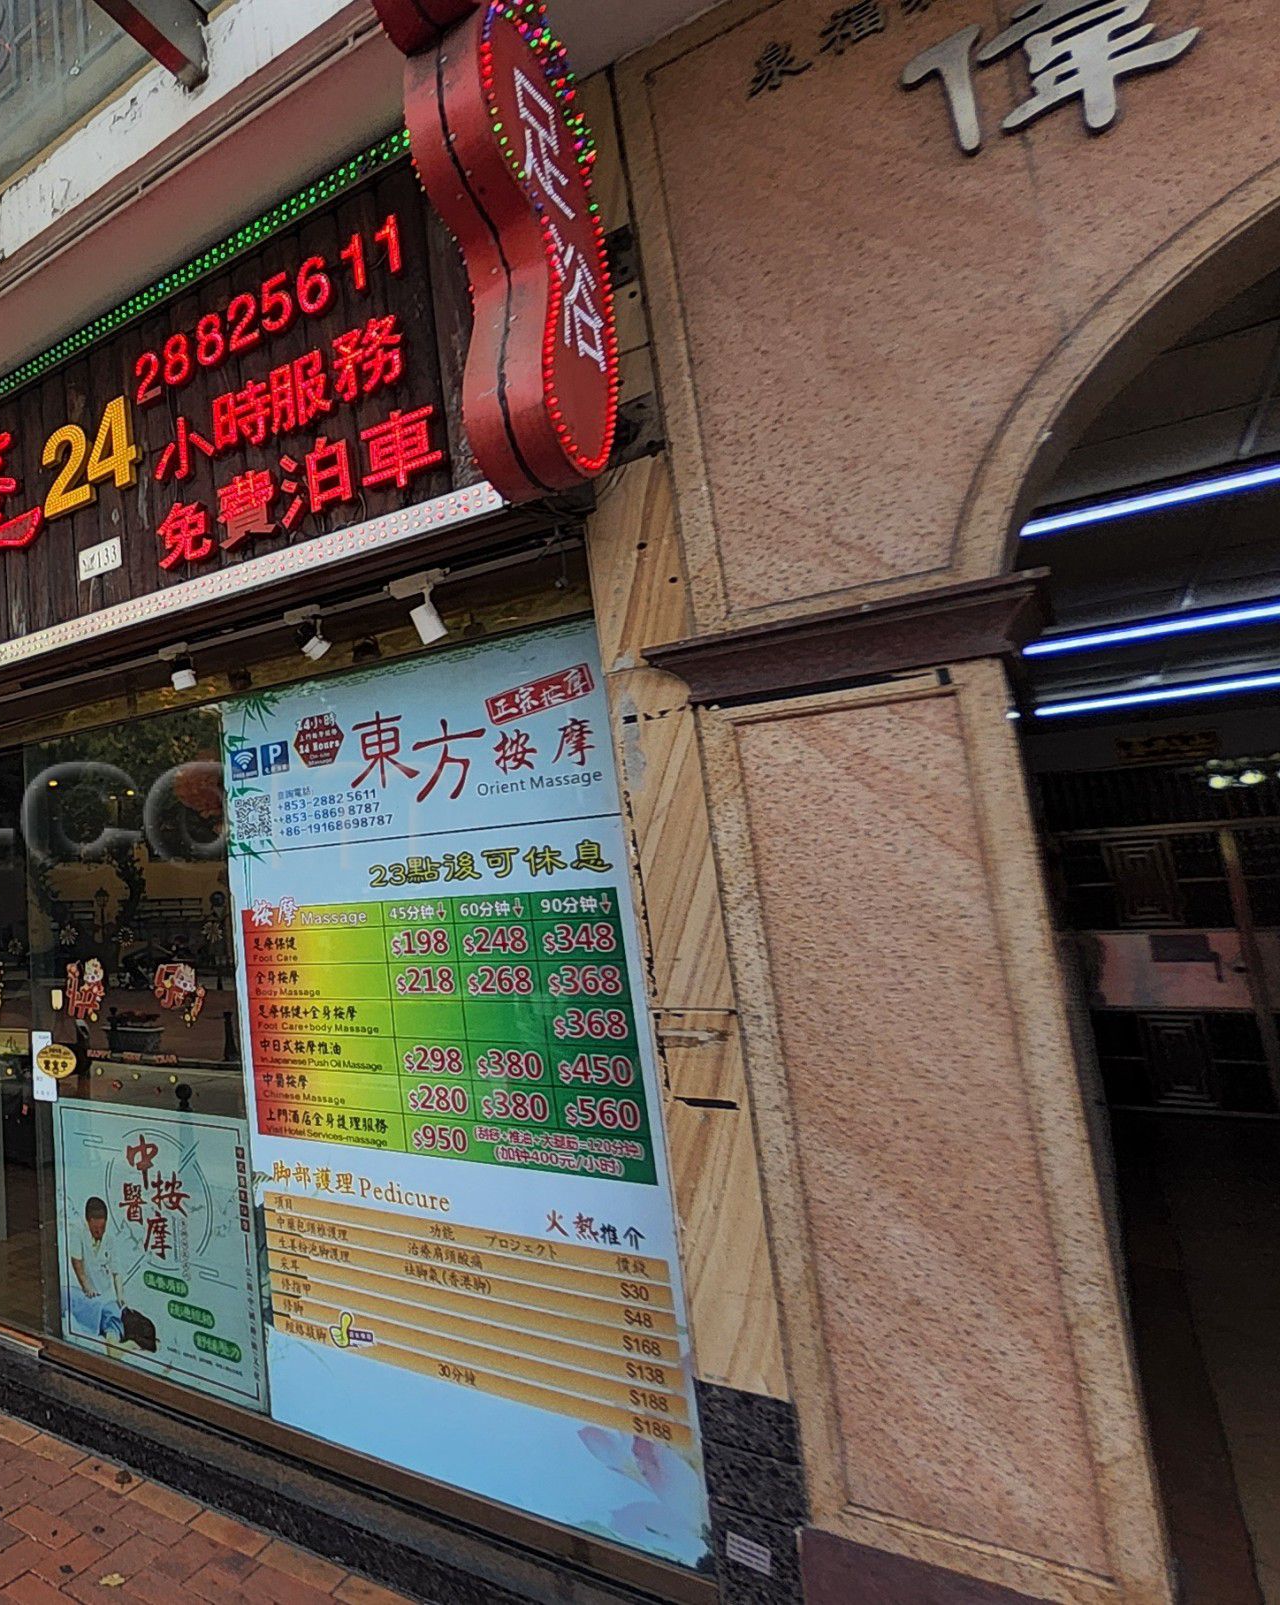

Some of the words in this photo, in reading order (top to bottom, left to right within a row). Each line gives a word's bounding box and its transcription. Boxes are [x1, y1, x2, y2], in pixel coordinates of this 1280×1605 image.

[513, 66, 607, 372] 足浴
[135, 212, 404, 405] 28825611
[154, 312, 404, 483] 小時服務
[41, 395, 142, 519] 24
[156, 404, 443, 572] 免費泊車
[313, 740, 340, 751] Hours
[351, 711, 487, 804] 東方
[493, 717, 596, 775] 按摩
[477, 778, 527, 798] Orient
[529, 768, 605, 794] Massage
[278, 794, 344, 812] +853-2882
[347, 788, 377, 802] 5611
[278, 807, 345, 825] +853-6869
[348, 801, 381, 816] 8787
[279, 814, 393, 838] +86-19168698787
[368, 838, 615, 889] 23點後可休息
[251, 896, 300, 927] 按摩
[301, 910, 368, 926] Massage
[389, 905, 436, 921] 45分钟
[460, 901, 511, 919] 60分钟
[540, 897, 600, 915] 90分钟
[391, 927, 451, 957] $198
[463, 925, 530, 956] $248
[542, 921, 616, 954] $348
[253, 954, 274, 962] Foot
[276, 953, 299, 962] Care
[255, 970, 300, 986] 全身按摩
[396, 966, 456, 996] $218
[467, 965, 533, 997] $268
[547, 965, 623, 997] $368
[279, 988, 321, 999] Massage
[258, 1022, 278, 1031] Foot
[281, 1022, 333, 1033] Care+body
[334, 1024, 380, 1035] Massage
[552, 1007, 629, 1041] $368
[308, 1058, 330, 1068] Push
[330, 1059, 342, 1068] Oil
[342, 1060, 383, 1072] Massage
[402, 1046, 465, 1076] $298
[477, 1050, 543, 1080] $380
[558, 1054, 633, 1087] $450
[262, 1089, 301, 1100] Chinese
[302, 1091, 346, 1106] Massage
[408, 1085, 468, 1115] $280
[482, 1088, 550, 1122] $380
[565, 1099, 641, 1131] $560
[284, 1126, 306, 1136] Hotel
[412, 1123, 469, 1154] $950
[359, 1177, 451, 1212] Pedicure
[545, 1208, 648, 1251] 火熱推介
[484, 1233, 559, 1260] プロジェクト
[620, 1281, 650, 1302] $30
[624, 1309, 653, 1329] $48
[622, 1334, 662, 1358] $168
[625, 1361, 665, 1386] $138
[628, 1388, 669, 1413] $188
[632, 1415, 673, 1442] $188
